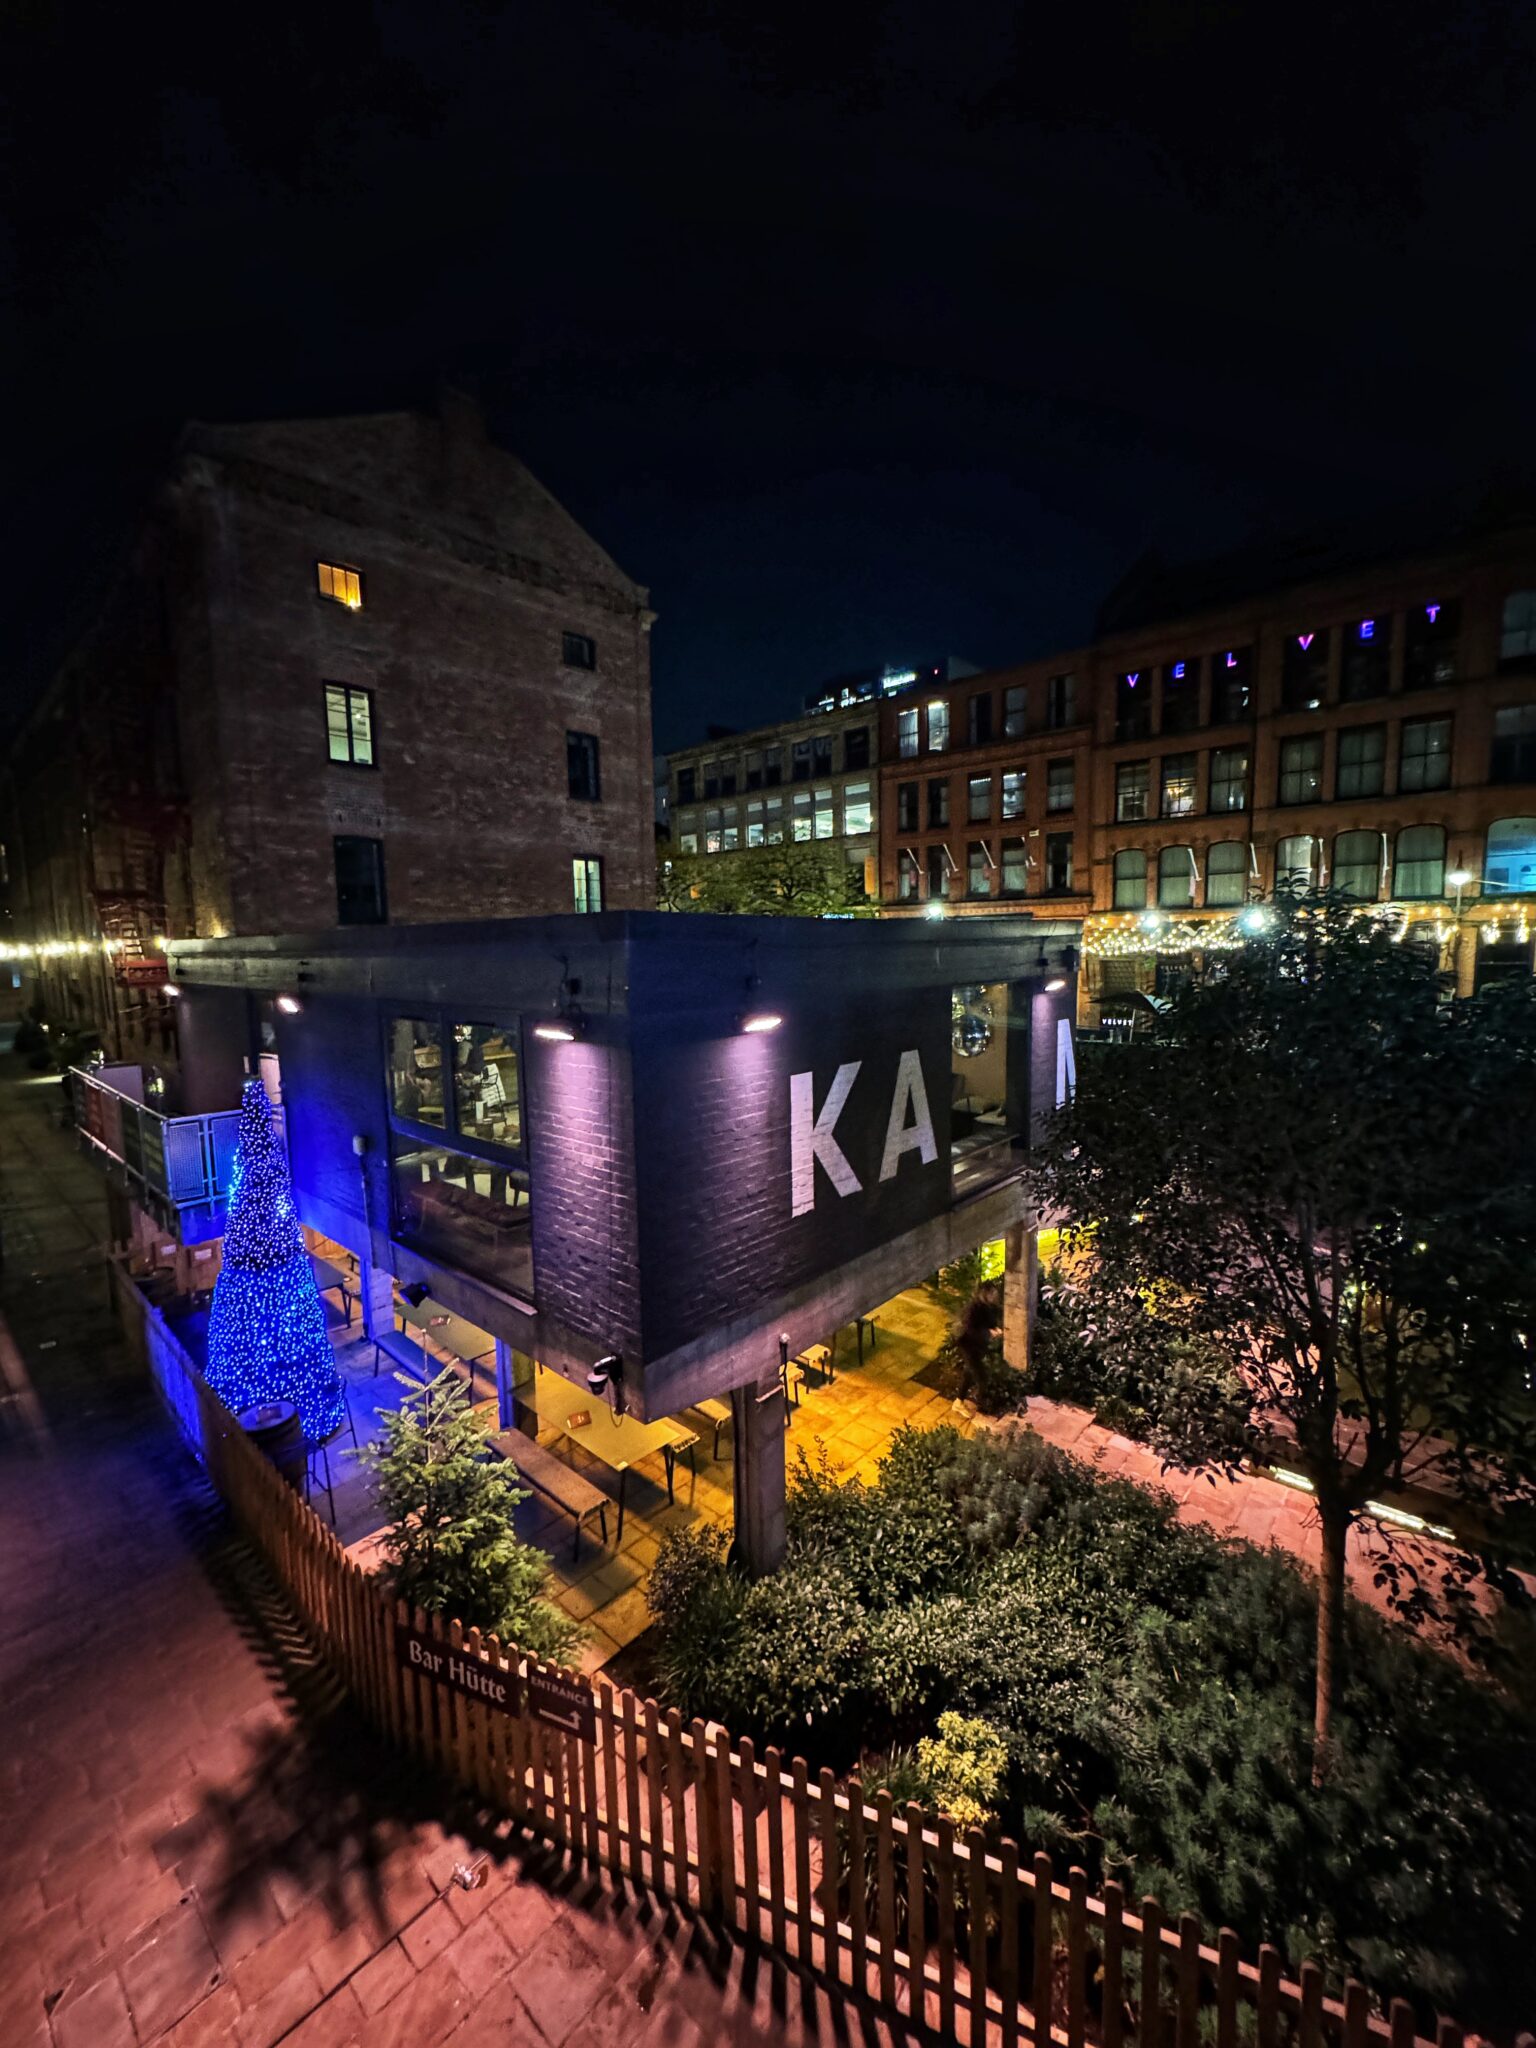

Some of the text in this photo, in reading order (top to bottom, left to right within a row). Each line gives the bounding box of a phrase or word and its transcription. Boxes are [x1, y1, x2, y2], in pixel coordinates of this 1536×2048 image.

[1127, 603, 1441, 689] VELVET
[1101, 1018, 1134, 1026] VELVET
[409, 1640, 506, 1703] Bar Hütte
[530, 1675, 588, 1707] ENTRANCE
